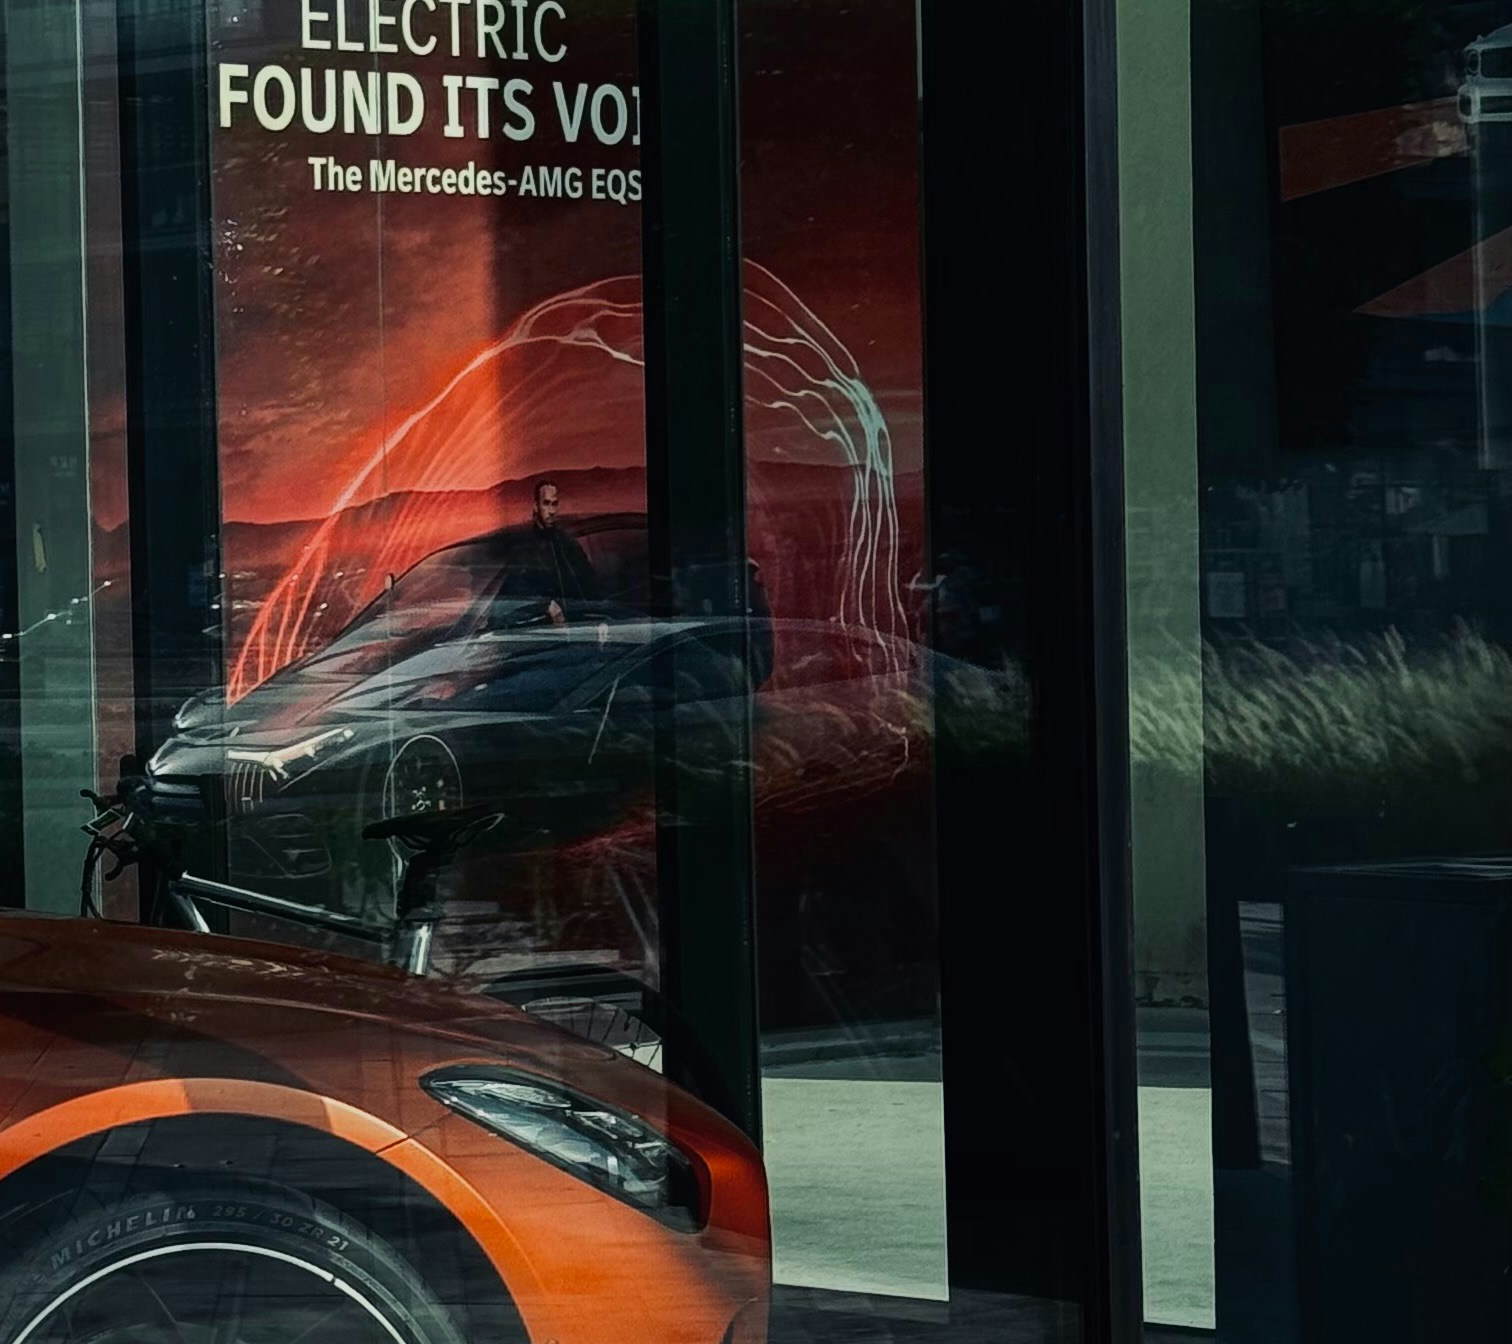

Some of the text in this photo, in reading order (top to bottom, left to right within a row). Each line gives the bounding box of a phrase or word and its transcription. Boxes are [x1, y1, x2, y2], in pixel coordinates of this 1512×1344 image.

[218, 62, 425, 137] FOUND
[442, 74, 535, 142] ITS
[307, 156, 643, 206] The Mercedes-AMG EQS
[50, 1206, 196, 1270] MICHELIN
[326, 1235, 351, 1252] 21
